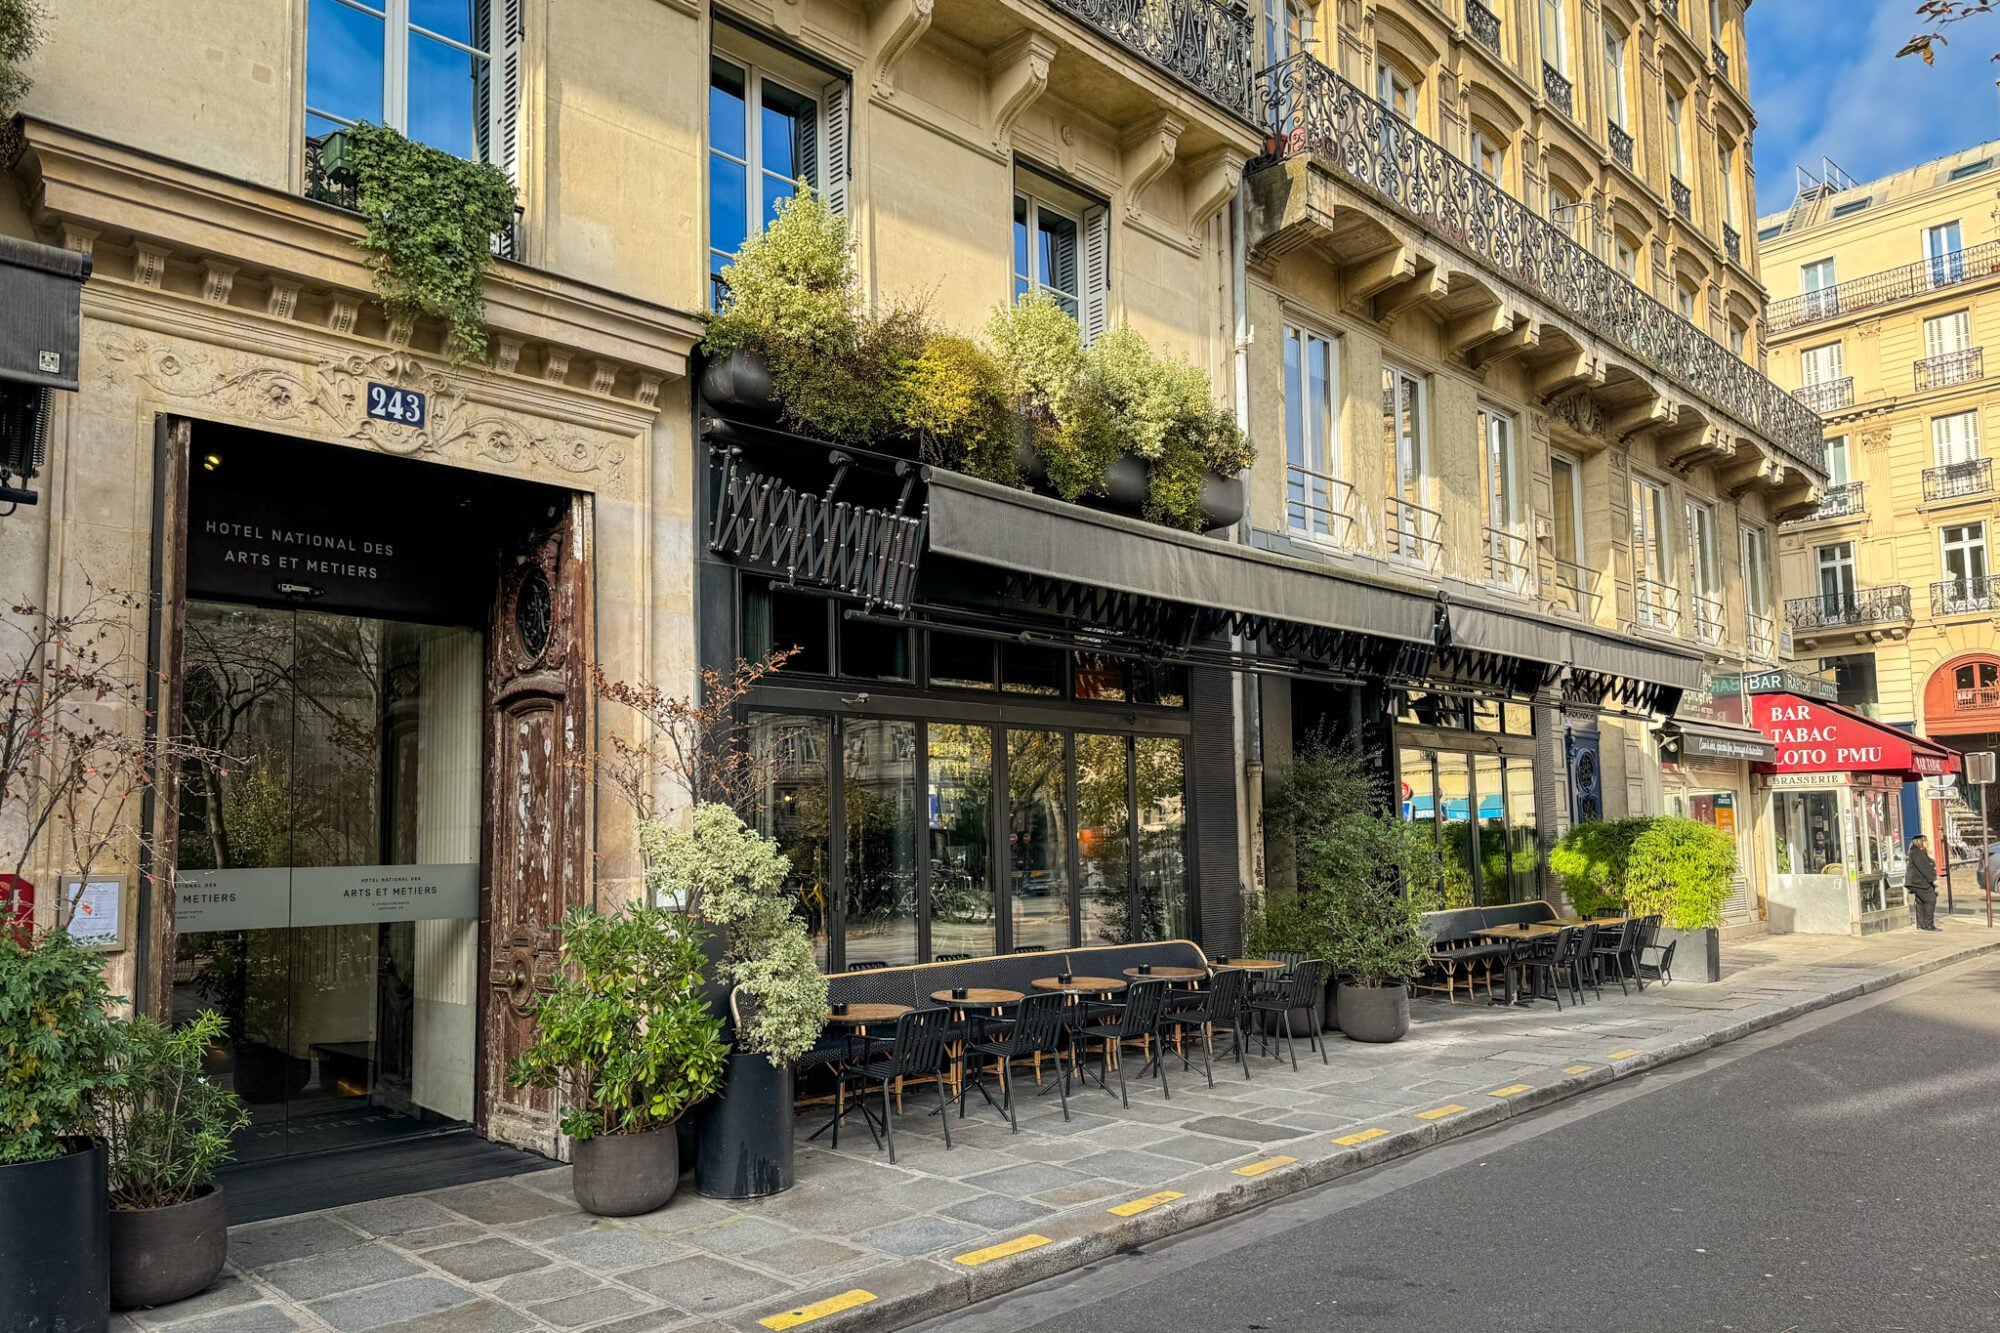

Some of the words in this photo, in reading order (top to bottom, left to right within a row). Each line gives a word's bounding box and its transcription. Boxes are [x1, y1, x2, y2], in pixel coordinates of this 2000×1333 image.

[371, 387, 420, 422] 243
[206, 520, 263, 539] HOTEL
[271, 529, 357, 551] NATIONAL
[363, 542, 394, 557] DES
[224, 550, 271, 566] ARTS
[279, 556, 299, 569] ET
[306, 559, 378, 579] METIERS
[1749, 675, 1781, 689] BAR
[1818, 681, 1834, 698] LOTO
[1771, 705, 1811, 722] BAR
[1771, 726, 1837, 743] TABAC
[1773, 748, 1827, 765] LOTO
[1836, 747, 1883, 763] PMU
[1772, 774, 1839, 785] BRASSERIE
[183, 893, 237, 904] METIERS
[343, 888, 371, 897] ARTS
[376, 888, 388, 896] ET
[393, 886, 438, 896] METIERS
